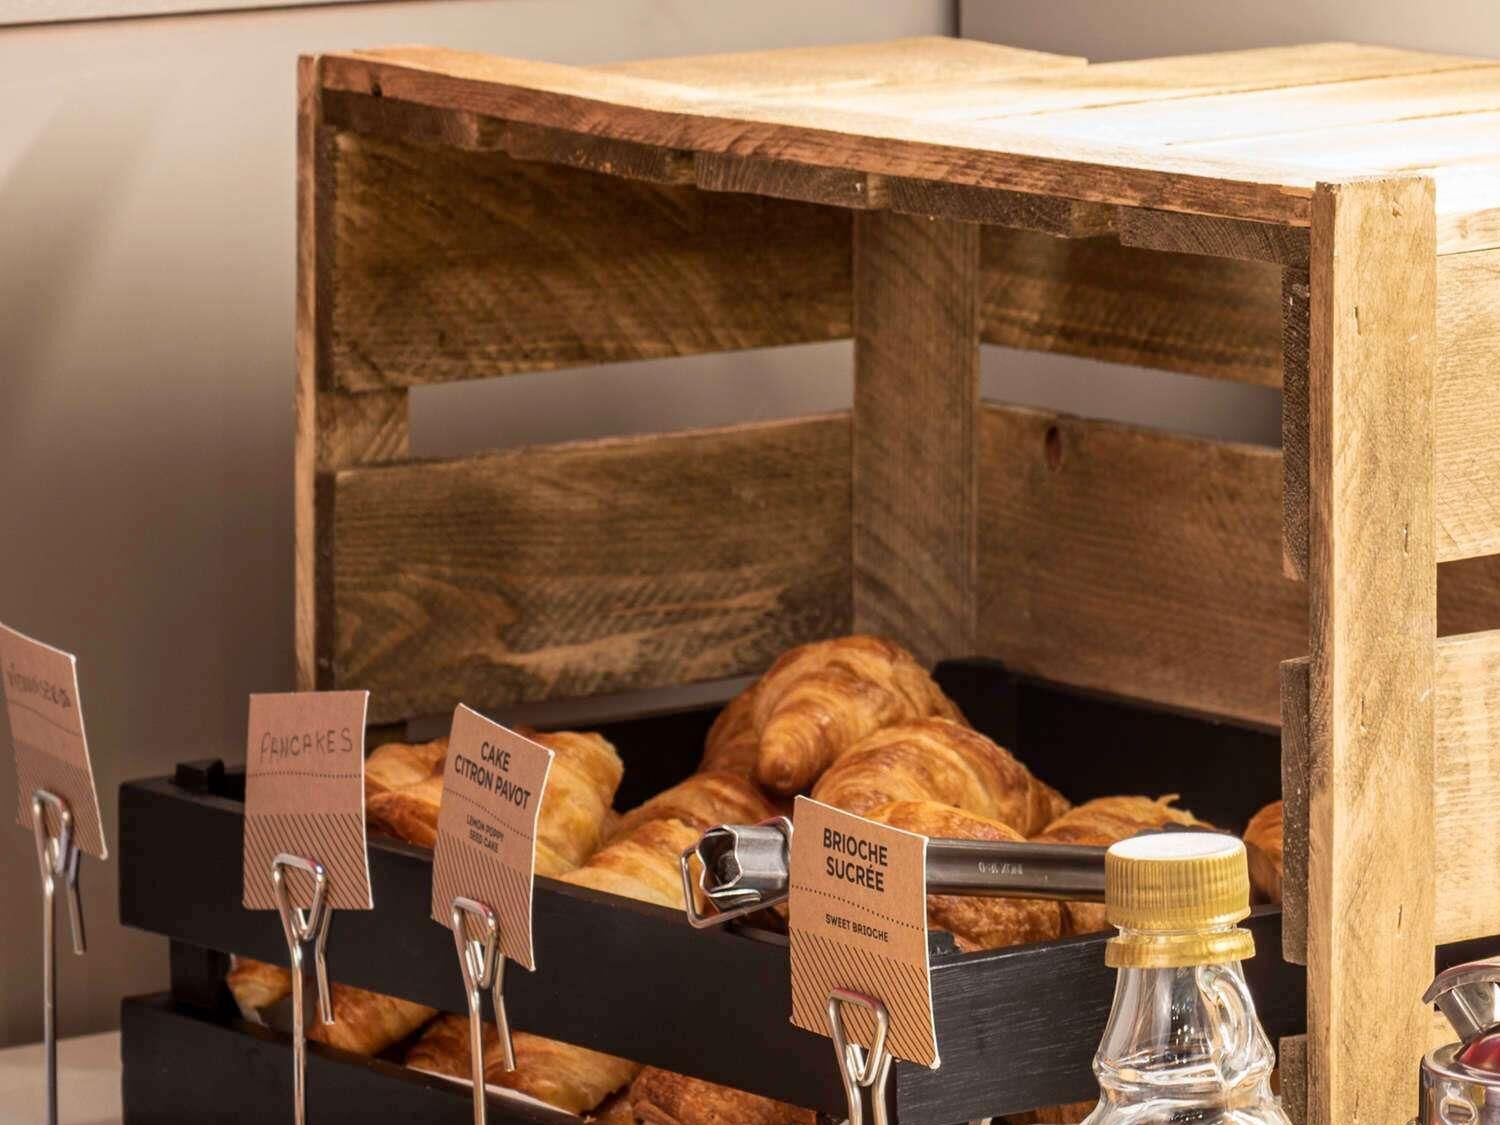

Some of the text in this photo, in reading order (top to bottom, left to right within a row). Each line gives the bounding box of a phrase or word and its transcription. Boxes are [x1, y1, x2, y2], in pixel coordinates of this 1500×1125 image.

[260, 727, 353, 763] PANCAKES
[480, 741, 511, 772] CAKE
[454, 754, 531, 810] CITRON PAVOT
[823, 827, 888, 867] BRIOCHE
[826, 856, 885, 893] SUCRÉE
[825, 914, 889, 943] SWEET BRIOCHE
